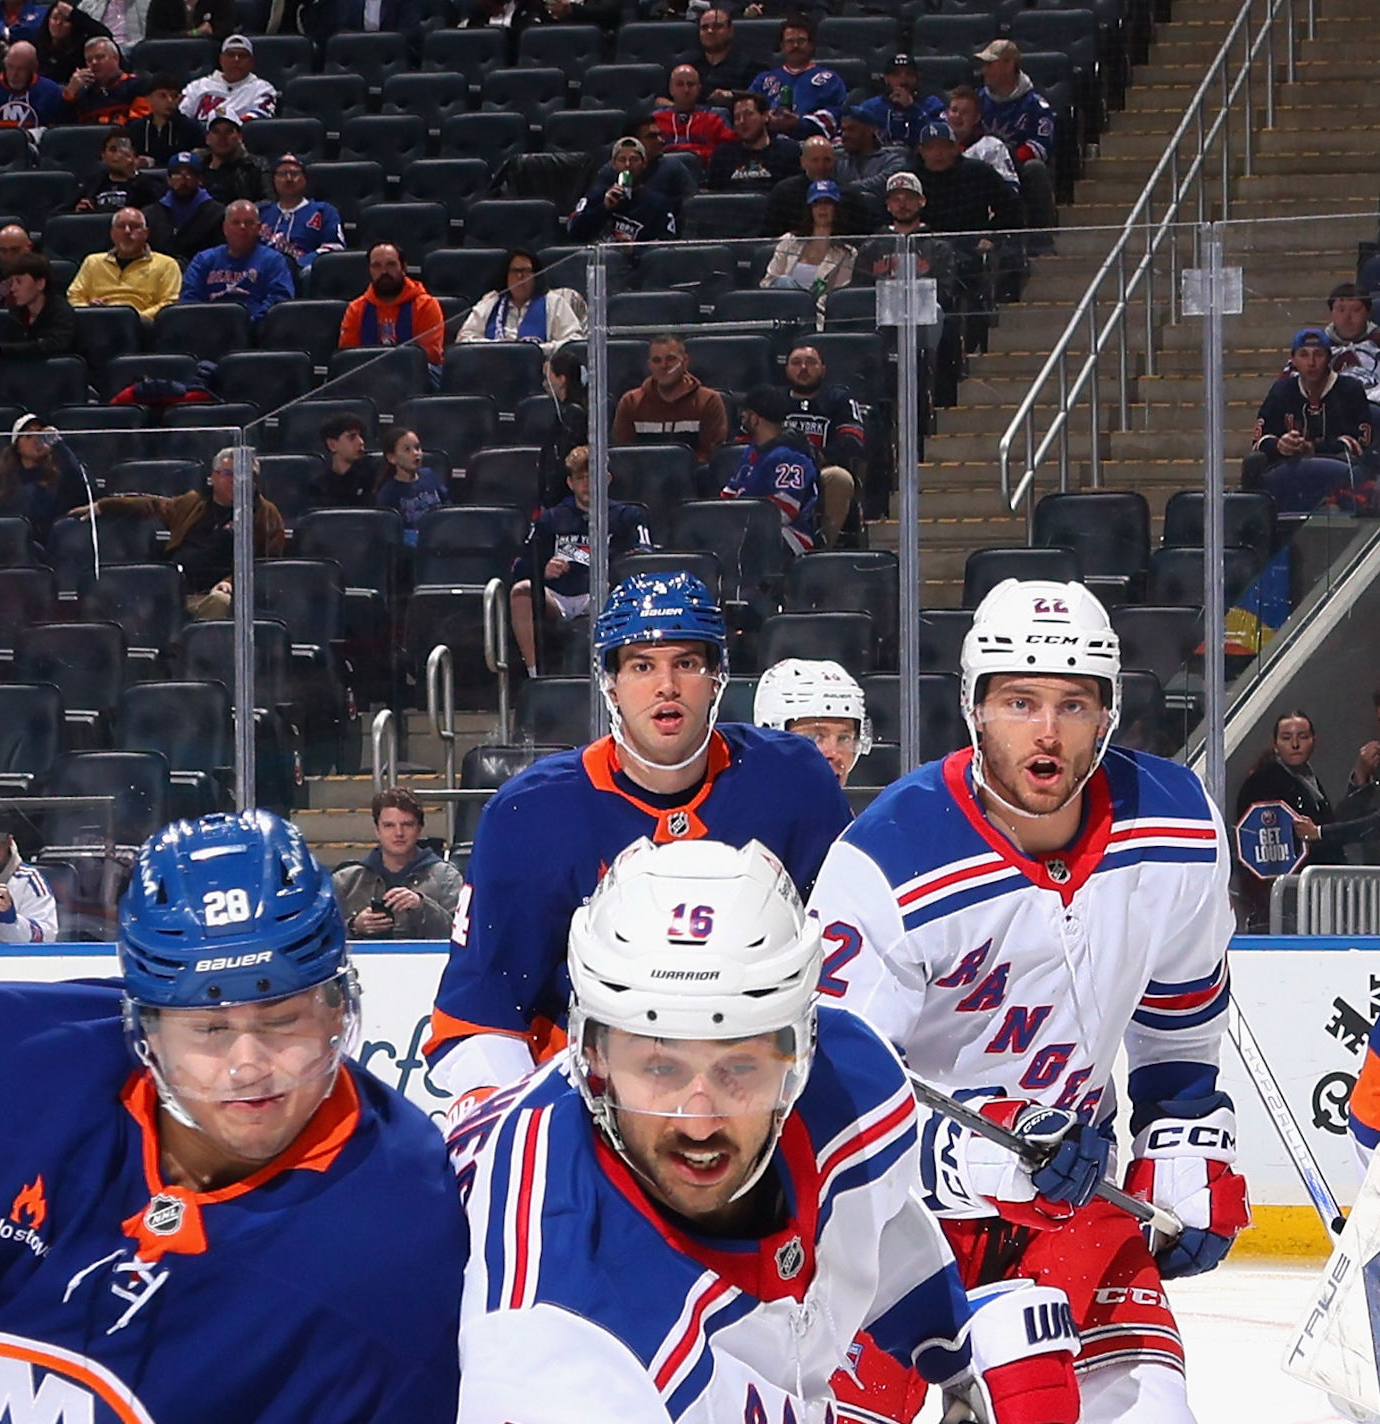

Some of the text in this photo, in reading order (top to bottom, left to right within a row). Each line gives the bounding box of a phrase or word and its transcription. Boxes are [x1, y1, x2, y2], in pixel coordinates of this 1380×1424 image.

[776, 464, 804, 488] 23
[639, 606, 683, 618] BAUER
[1033, 598, 1069, 614] 22
[1025, 634, 1080, 646] CCM
[1258, 827, 1285, 846] GET
[1255, 844, 1290, 865] LOUD!
[202, 888, 251, 928] 28
[667, 903, 716, 940] 16
[194, 951, 274, 973] BAUER
[807, 909, 863, 999] 2
[650, 969, 721, 981] WARRIOR
[934, 937, 1104, 1125] RANGE
[1022, 1109, 1055, 1133] CCM
[1148, 1124, 1237, 1151] CCM
[1288, 1252, 1351, 1366] TRUE
